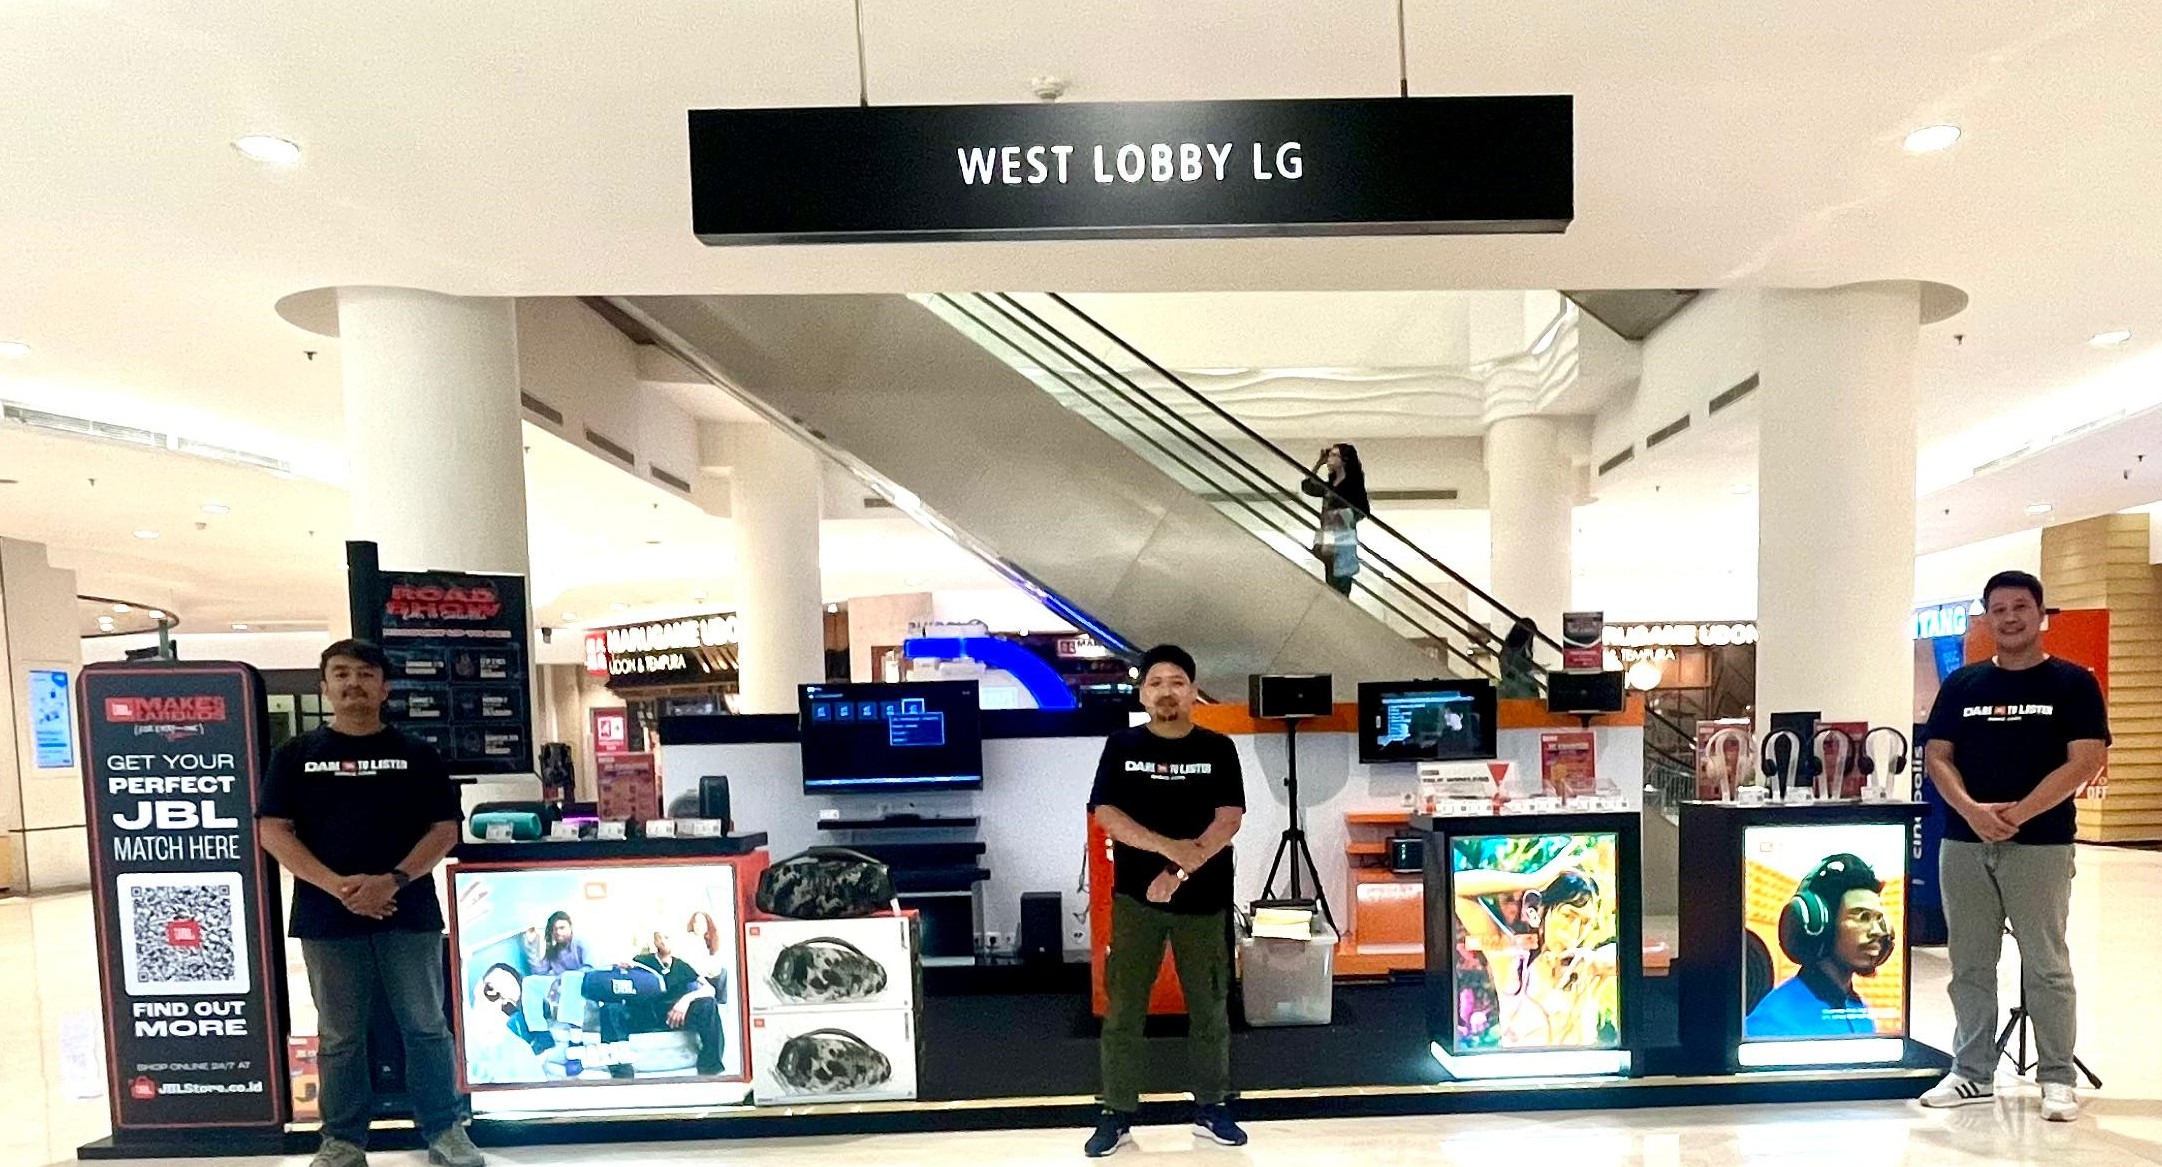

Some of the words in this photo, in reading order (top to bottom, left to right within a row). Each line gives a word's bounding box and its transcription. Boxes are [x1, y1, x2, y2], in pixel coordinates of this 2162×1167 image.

[957, 145, 1074, 185] WEST
[1094, 142, 1233, 184] LOBBY
[1253, 141, 1304, 180] LG
[391, 585, 496, 602] ROAD
[606, 620, 700, 654] MARUGAME
[700, 616, 738, 646] UDO
[609, 659, 637, 676] UDON
[646, 654, 687, 672] TEMPURA
[107, 755, 156, 771] GET
[162, 753, 235, 770] YOUR
[108, 776, 236, 795] PERFECT
[112, 800, 239, 831] JBL
[113, 836, 184, 862] MATCH
[189, 834, 241, 861] HERE
[132, 1001, 189, 1018] FIND
[194, 1001, 246, 1016] OUT
[134, 1019, 248, 1037] MORE
[237, 1061, 251, 1069] AT
